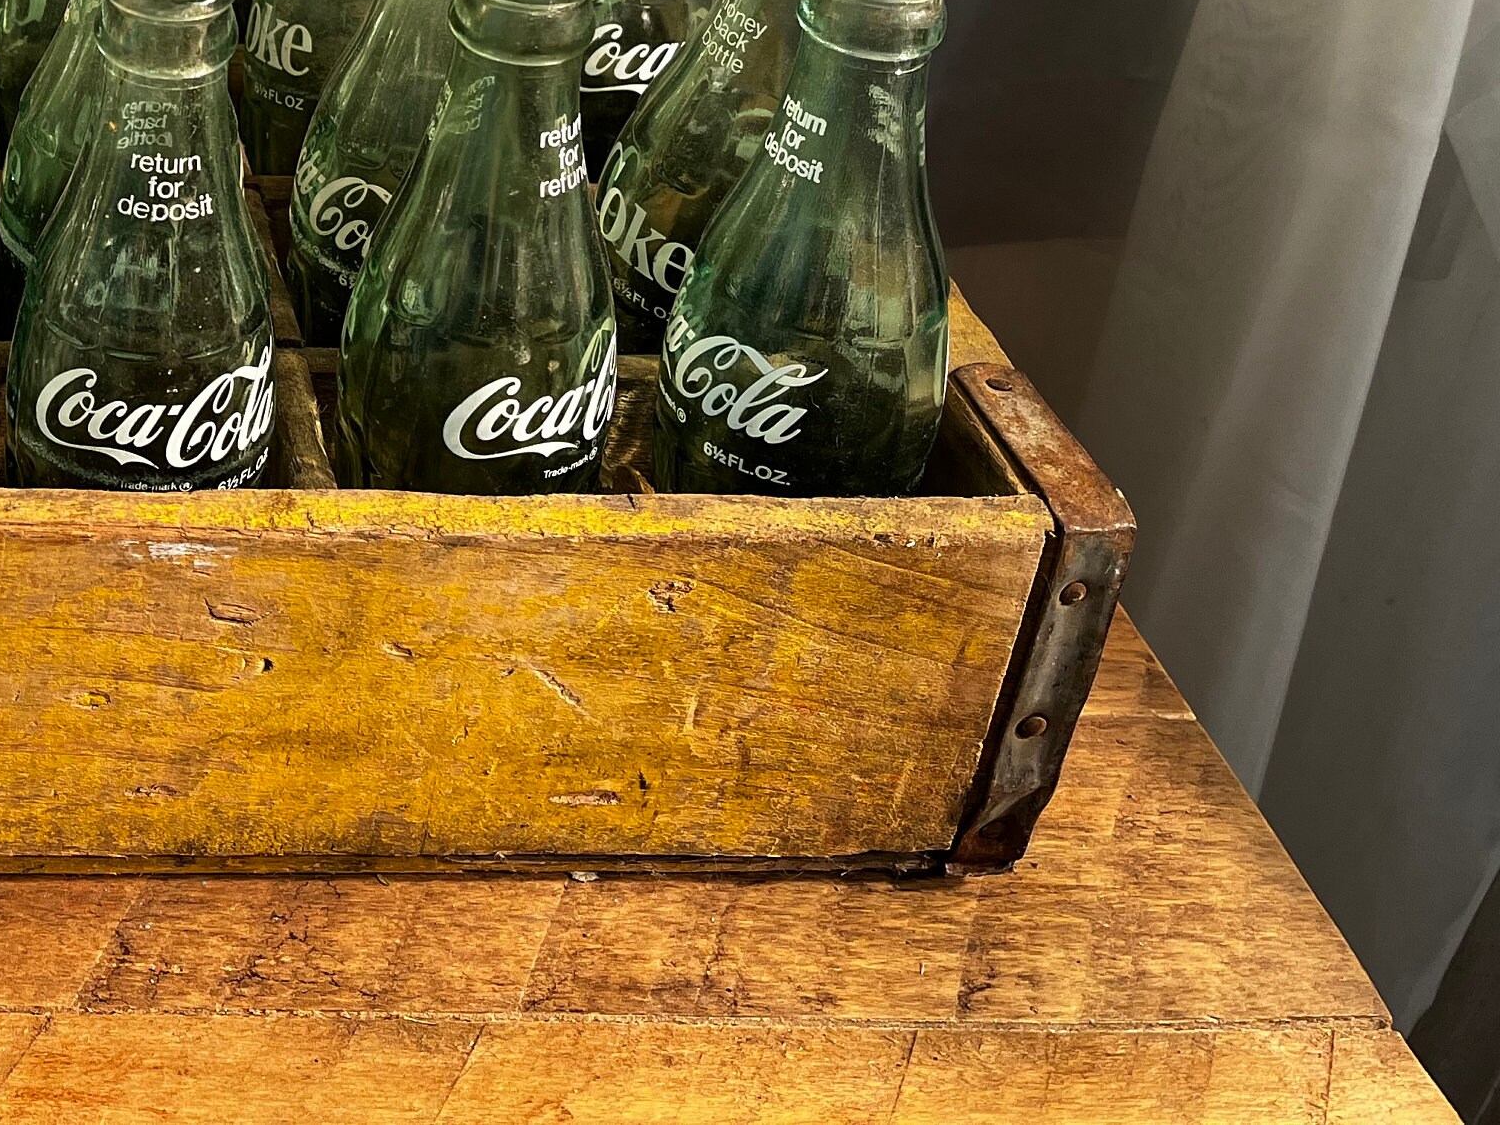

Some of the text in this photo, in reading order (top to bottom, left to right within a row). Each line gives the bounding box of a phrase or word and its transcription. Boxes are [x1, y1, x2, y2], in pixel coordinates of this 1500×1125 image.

[245, 1, 313, 77] oke
[702, 23, 744, 74] bottle
[713, 8, 750, 53] back
[780, 121, 806, 150] for
[782, 93, 828, 136] return
[130, 152, 202, 175] return
[558, 143, 579, 170] for
[764, 131, 824, 184] deposit
[117, 193, 214, 223] deposit
[148, 175, 185, 199] for
[668, 314, 830, 445] a-Cola
[36, 335, 274, 470] Coca-Cola
